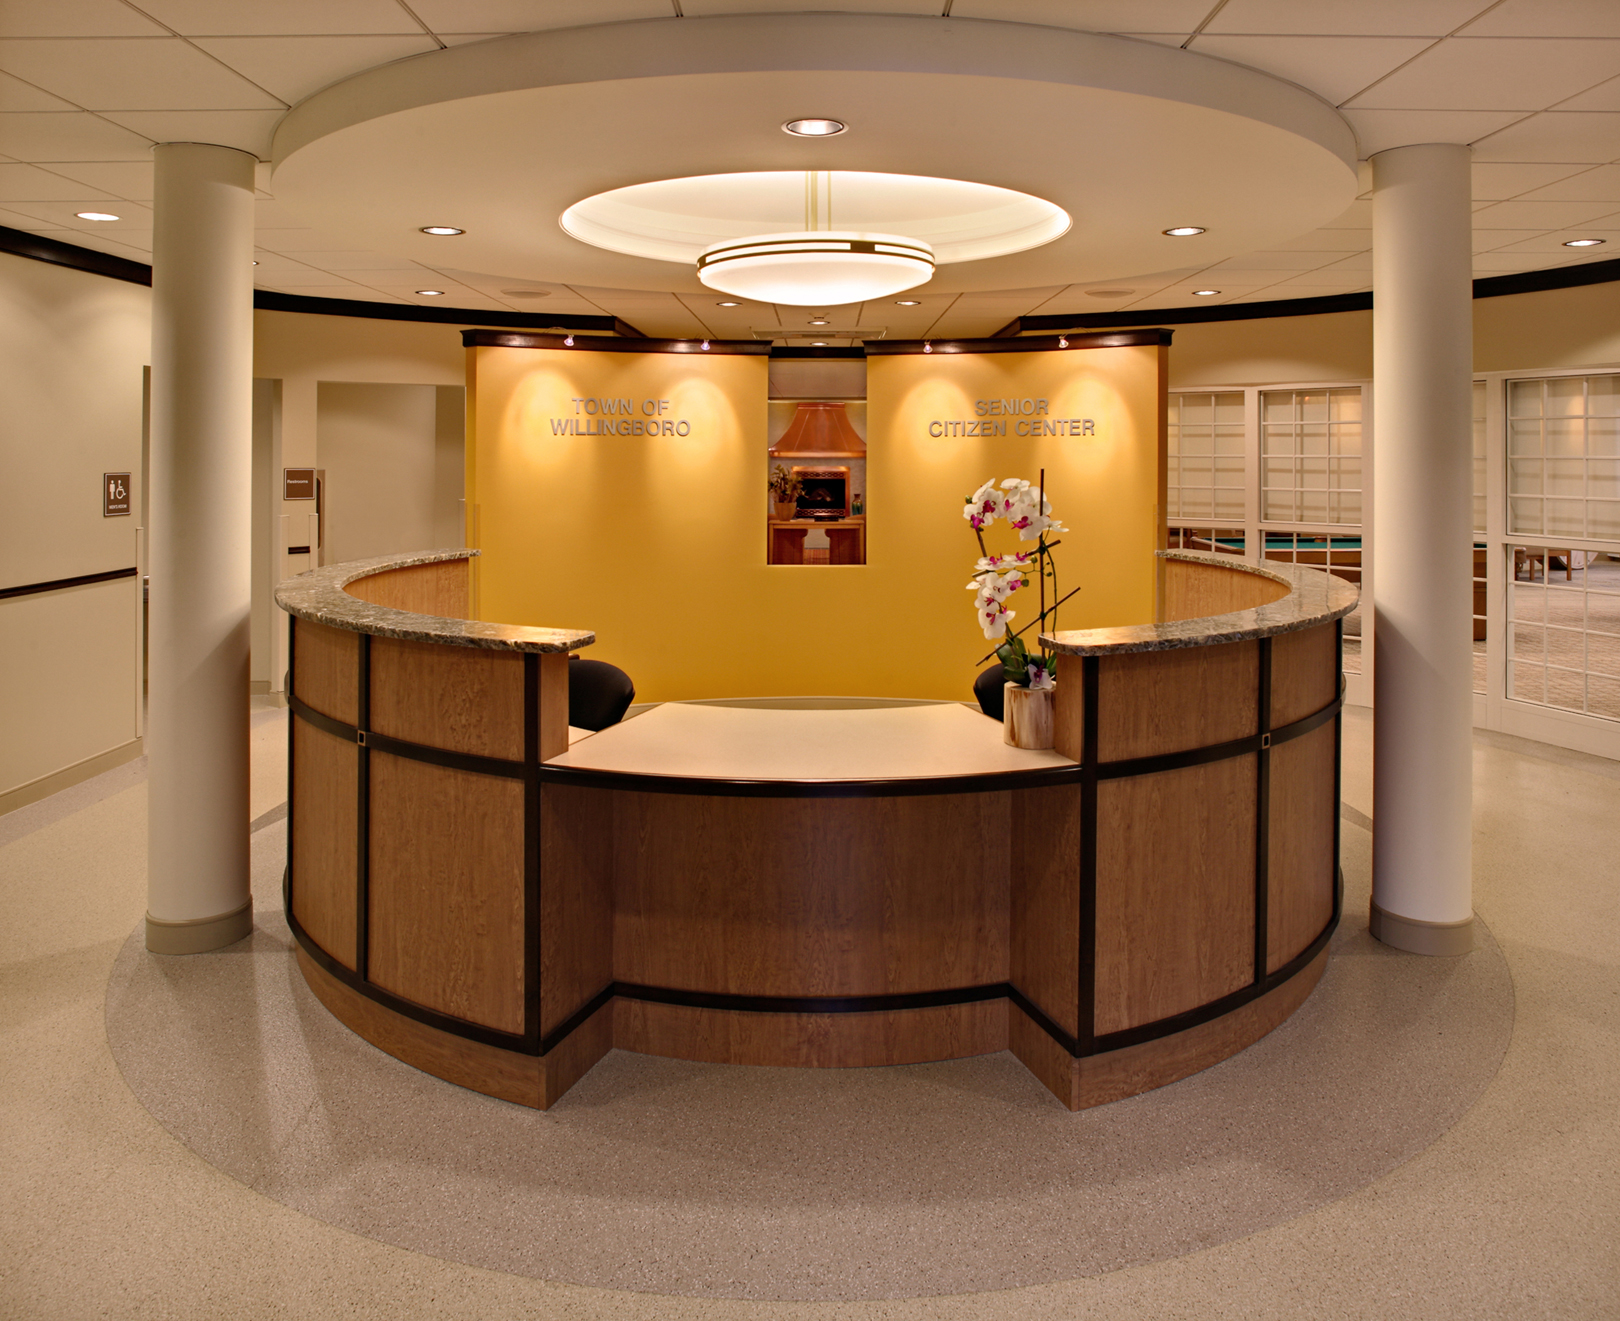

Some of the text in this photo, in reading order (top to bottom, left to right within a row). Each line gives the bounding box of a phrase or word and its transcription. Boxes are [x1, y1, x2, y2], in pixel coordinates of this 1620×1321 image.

[572, 397, 670, 416] TOWN OF
[974, 398, 1049, 416] SENIOR
[550, 418, 691, 436] WILLINGBORO
[928, 418, 1096, 438] CITIZEN CENTER
